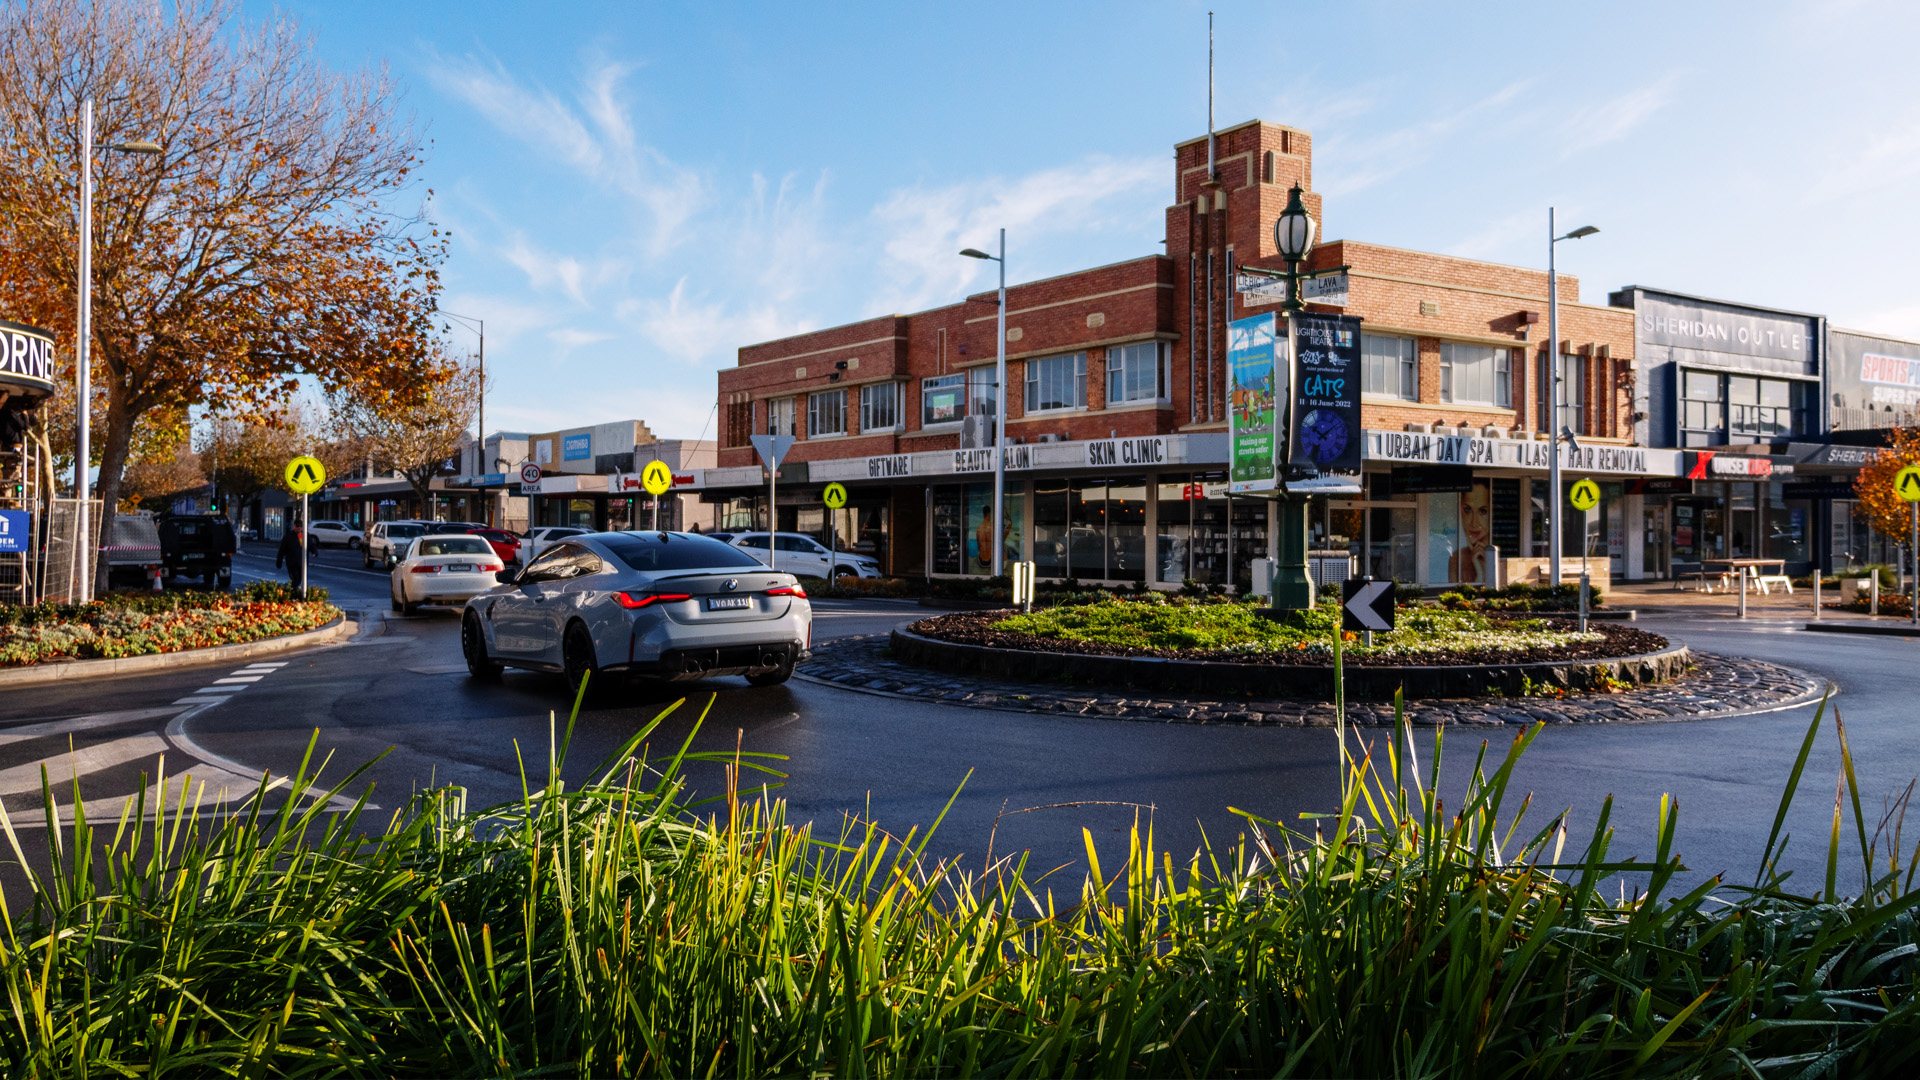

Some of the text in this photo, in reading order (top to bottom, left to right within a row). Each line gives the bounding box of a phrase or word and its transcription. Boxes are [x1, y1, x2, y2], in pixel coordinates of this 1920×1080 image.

[1237, 275, 1261, 288] LIEBIG
[1318, 276, 1337, 289] LAVA
[1295, 327, 1333, 337] LIGHTHOUSE
[1643, 314, 1727, 341] SHERIDAN
[1310, 337, 1333, 346] THEATRE
[1304, 374, 1345, 398] CATS
[1872, 386, 1905, 403] SUPER
[1318, 399, 1335, 407] June
[1335, 400, 1351, 408] 2022
[1238, 446, 1269, 455] streets safer
[1240, 438, 1257, 447] Making
[1386, 433, 1493, 463] URBAN DAY SPA
[955, 446, 1030, 472] BEAUTY ALON
[1089, 438, 1163, 465] SKIN CLINIC
[1568, 448, 1594, 469] HAIR
[1599, 449, 1647, 471] REMOVAL
[524, 469, 539, 478] 40
[868, 456, 908, 477] GIFTWARE
[1711, 456, 1749, 474] UNISEX
